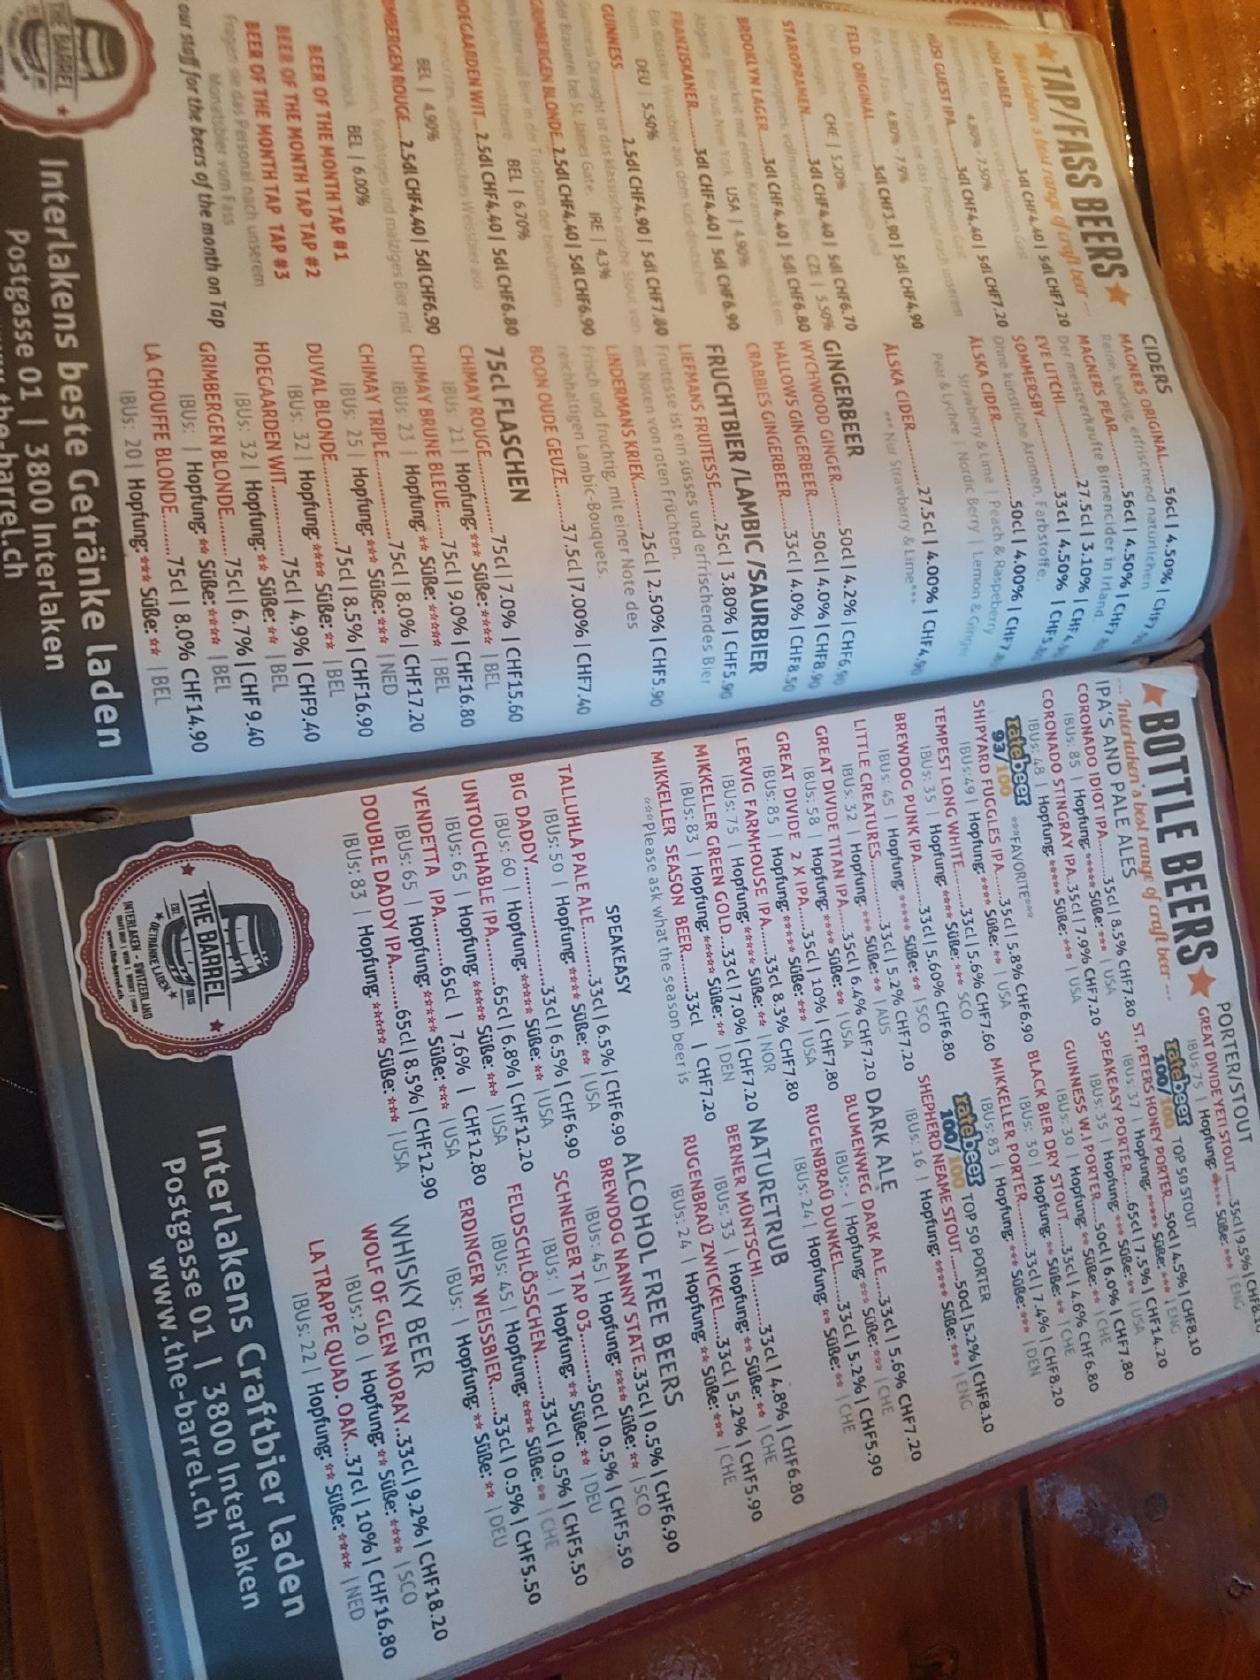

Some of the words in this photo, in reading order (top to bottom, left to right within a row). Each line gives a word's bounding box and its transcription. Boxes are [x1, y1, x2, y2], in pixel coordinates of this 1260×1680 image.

[1035, 63, 1103, 188] TAP/FASS
[1072, 197, 1129, 278] BEERS
[39, 159, 81, 348] Interlakens
[4, 229, 35, 357] Postgasse
[18, 366, 44, 400] 01
[199, 341, 227, 445] GRIMBERGEN
[253, 341, 283, 450] HOEGAARDEN
[459, 344, 483, 403] CHIMAY
[485, 346, 511, 391] 75cl
[773, 340, 800, 407] HALLOWS
[823, 339, 865, 456] GINGERBEER
[1078, 334, 1106, 396] MAGNERS
[1142, 333, 1174, 394] CIDERS
[58, 361, 91, 456] beste
[147, 367, 171, 440] CHOUFFE
[706, 344, 747, 462] FRUCHTBIER
[25, 443, 55, 513] 3800
[493, 397, 532, 502] FLASCHEN
[678, 343, 705, 412] LIEFMANS
[721, 571, 738, 624] 3.80%
[799, 339, 831, 425] WYCHWOOD
[844, 574, 858, 616] 4.2%
[306, 342, 328, 395] DUVAL
[342, 596, 364, 643] 8.5%
[606, 345, 637, 437] LINDERMANS
[647, 579, 666, 633] 2.50%
[69, 469, 112, 630] Getränke
[358, 343, 382, 403] CHIMAY
[404, 653, 426, 732] CHF17.20
[32, 523, 66, 670] Interlaken
[232, 608, 254, 656] 6.7%
[289, 609, 311, 656] 4.9%
[448, 590, 469, 635] 9.0%
[499, 583, 517, 629] 7.0%
[174, 613, 196, 661] 8.0%
[86, 644, 124, 747] laden
[181, 667, 210, 752] CHF14.90
[240, 671, 261, 706] CHF
[298, 672, 321, 742] CHF9.40
[455, 650, 476, 727] CHF16.80
[506, 646, 524, 722] CHF15.60
[577, 652, 593, 715] CHF7.40
[245, 710, 266, 747] 9.40
[1000, 714, 1033, 806] ratebeer
[1077, 682, 1098, 767] CORONADO
[1103, 735, 1123, 775] AND
[1110, 781, 1131, 828] PALE
[1139, 709, 1200, 843] BOTTLE
[461, 778, 495, 905] UNTOUCHABLE
[935, 705, 952, 770] TEMPEST
[967, 950, 986, 989] 5.6%
[973, 699, 991, 774] SHIPYARD
[1015, 982, 1035, 1042] CHF6.90
[1118, 834, 1138, 878] ALES
[188, 888, 215, 927] THE
[653, 905, 669, 943] what
[744, 798, 769, 896] FARMHOUSE
[772, 992, 791, 1033] 8.3%
[894, 712, 914, 790] BREWDOG
[936, 1000, 956, 1061] CHF6.80
[1149, 904, 1169, 942] craft
[1161, 850, 1219, 965] BEERS
[197, 929, 226, 1004] BARREL
[558, 763, 585, 848] TALLUHLA
[606, 1079, 627, 1146] CHF6.90
[606, 904, 632, 993] SPEAKEASY
[707, 835, 726, 886] GREEN
[738, 1047, 759, 1112] CHF7.20
[1111, 918, 1128, 956] 8.5%
[1157, 946, 1171, 979] beer
[361, 794, 388, 866] DOUBLE
[414, 1117, 439, 1199] CHF12.90
[1084, 967, 1102, 1026] CHF7.20
[1119, 959, 1137, 1017] CHF7.80
[1198, 1005, 1216, 1047] GREAT
[1027, 1049, 1048, 1098] BLACK
[1205, 1050, 1223, 1097] DIVIDE
[1217, 1001, 1254, 1142] PORTER/STOUT
[844, 1093, 873, 1194] BLUMENWEG
[865, 1087, 891, 1148] DARK
[918, 1074, 943, 1150] SHEPHERD
[1037, 1101, 1054, 1135] BIER
[1172, 1135, 1187, 1163] TOP
[622, 1152, 658, 1264] ALCOHOL
[748, 1117, 790, 1266] NATURETRUB
[876, 1154, 899, 1193] ALE
[1064, 1039, 1088, 1114] GUINNESS
[1104, 1266, 1121, 1306] 6.0%
[1098, 1030, 1124, 1111] SPEAKEASY
[1146, 1296, 1169, 1368] CHF14.20
[1137, 1044, 1156, 1094] PETERS
[1181, 1298, 1203, 1356] CHF8.10
[1176, 1166, 1189, 1184] 50
[1180, 1186, 1198, 1228] STOUT
[162, 1156, 203, 1297] Postgasse
[361, 1223, 384, 1274] WOLF
[389, 1214, 424, 1307] WHISKY
[990, 1056, 1016, 1140] MIKKELLER
[1043, 1345, 1066, 1407] CHF8.20
[313, 1263, 341, 1336] TRAPPE
[370, 1279, 389, 1303] OF
[642, 1268, 670, 1327] FREE
[972, 1247, 992, 1302] PORTER
[189, 1305, 216, 1343] 01
[376, 1308, 398, 1356] GLEN
[406, 1316, 435, 1378] BEER
[726, 1123, 747, 1187] BERNER
[782, 1435, 806, 1505] CHF6.80
[148, 1256, 219, 1529] www.the-barrel.ch
[197, 1124, 254, 1332] Interlakens
[237, 1342, 287, 1504] Craftbier
[269, 1514, 305, 1617] laden
[324, 1339, 350, 1399] QUAD.
[459, 1196, 486, 1286] ERDINGER
[515, 1529, 542, 1605] CHF5.50
[553, 1169, 583, 1268] SCHNEIDER
[610, 1495, 635, 1569] CHF5.50
[653, 1332, 684, 1406] BEERS
[203, 1382, 237, 1455] 3800
[217, 1462, 260, 1610] Interlaken
